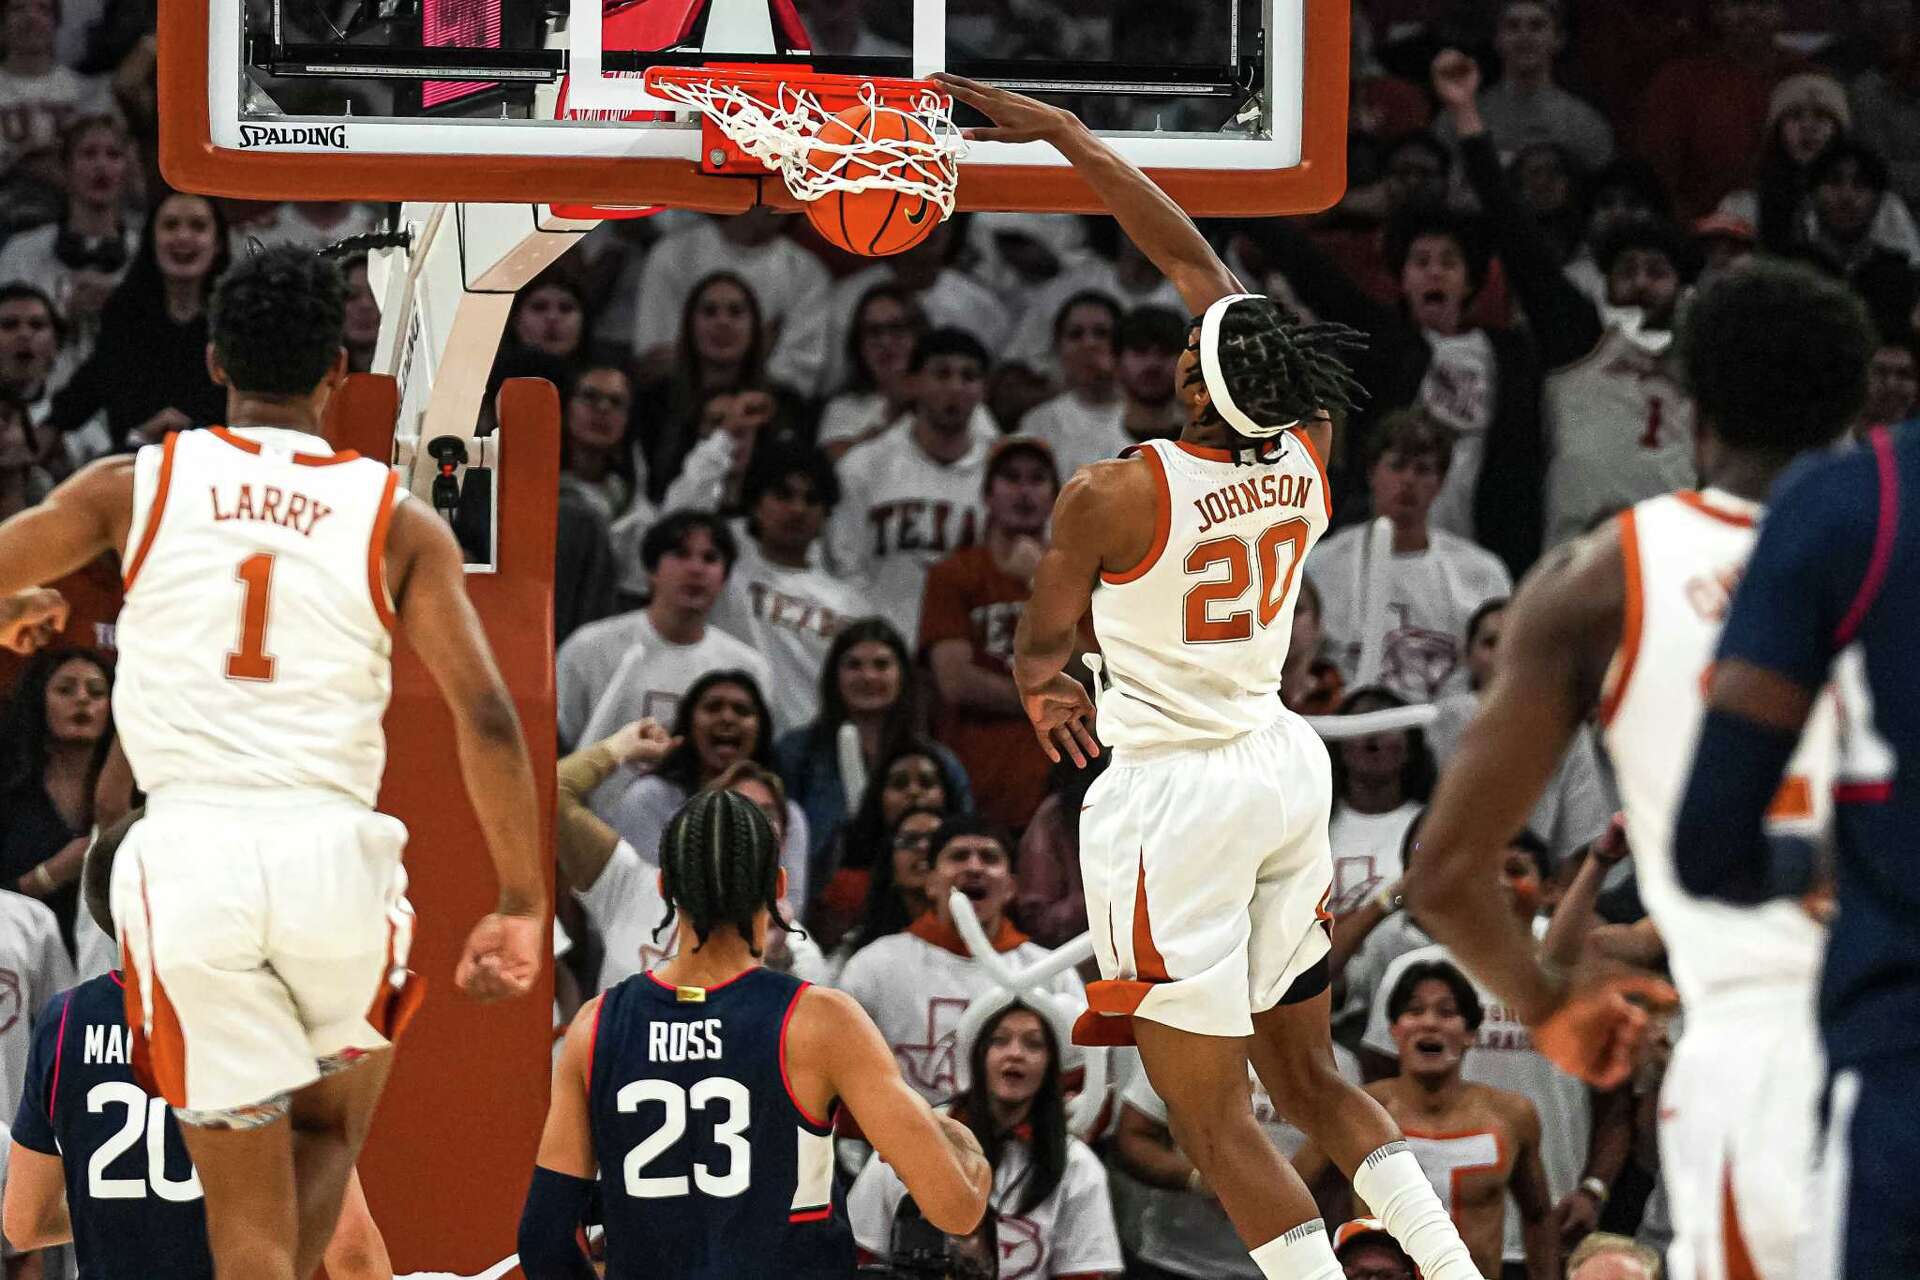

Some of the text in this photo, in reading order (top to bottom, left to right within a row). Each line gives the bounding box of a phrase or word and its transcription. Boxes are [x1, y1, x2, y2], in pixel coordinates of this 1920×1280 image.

[239, 125, 349, 149] SPALDING
[209, 485, 332, 537] LARRY
[1193, 475, 1312, 533] JOHNSON
[225, 551, 277, 682] 1
[1182, 516, 1311, 645] 20
[648, 1018, 723, 1063] ROSS
[86, 1081, 205, 1202] 20
[616, 1076, 751, 1199] 23
